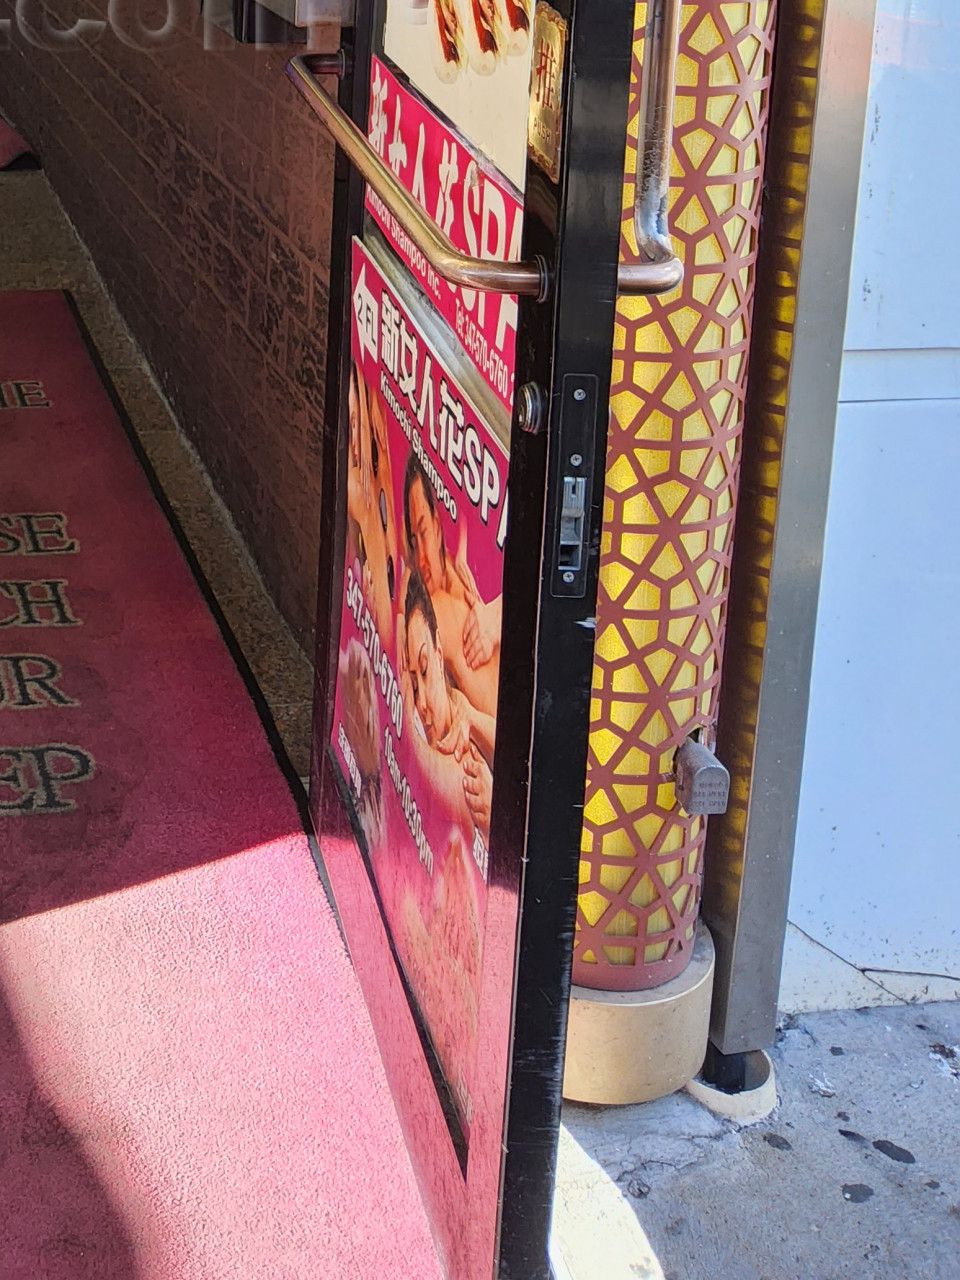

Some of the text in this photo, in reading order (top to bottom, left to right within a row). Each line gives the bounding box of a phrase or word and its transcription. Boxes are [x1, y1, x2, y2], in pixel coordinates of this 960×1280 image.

[533, 116, 553, 142] PUSH
[391, 216, 426, 277] Shampoo
[464, 318, 508, 399] 347-570-6760
[380, 369, 457, 521] Kimochi Shampoo
[381, 288, 509, 550] 新女人花SP
